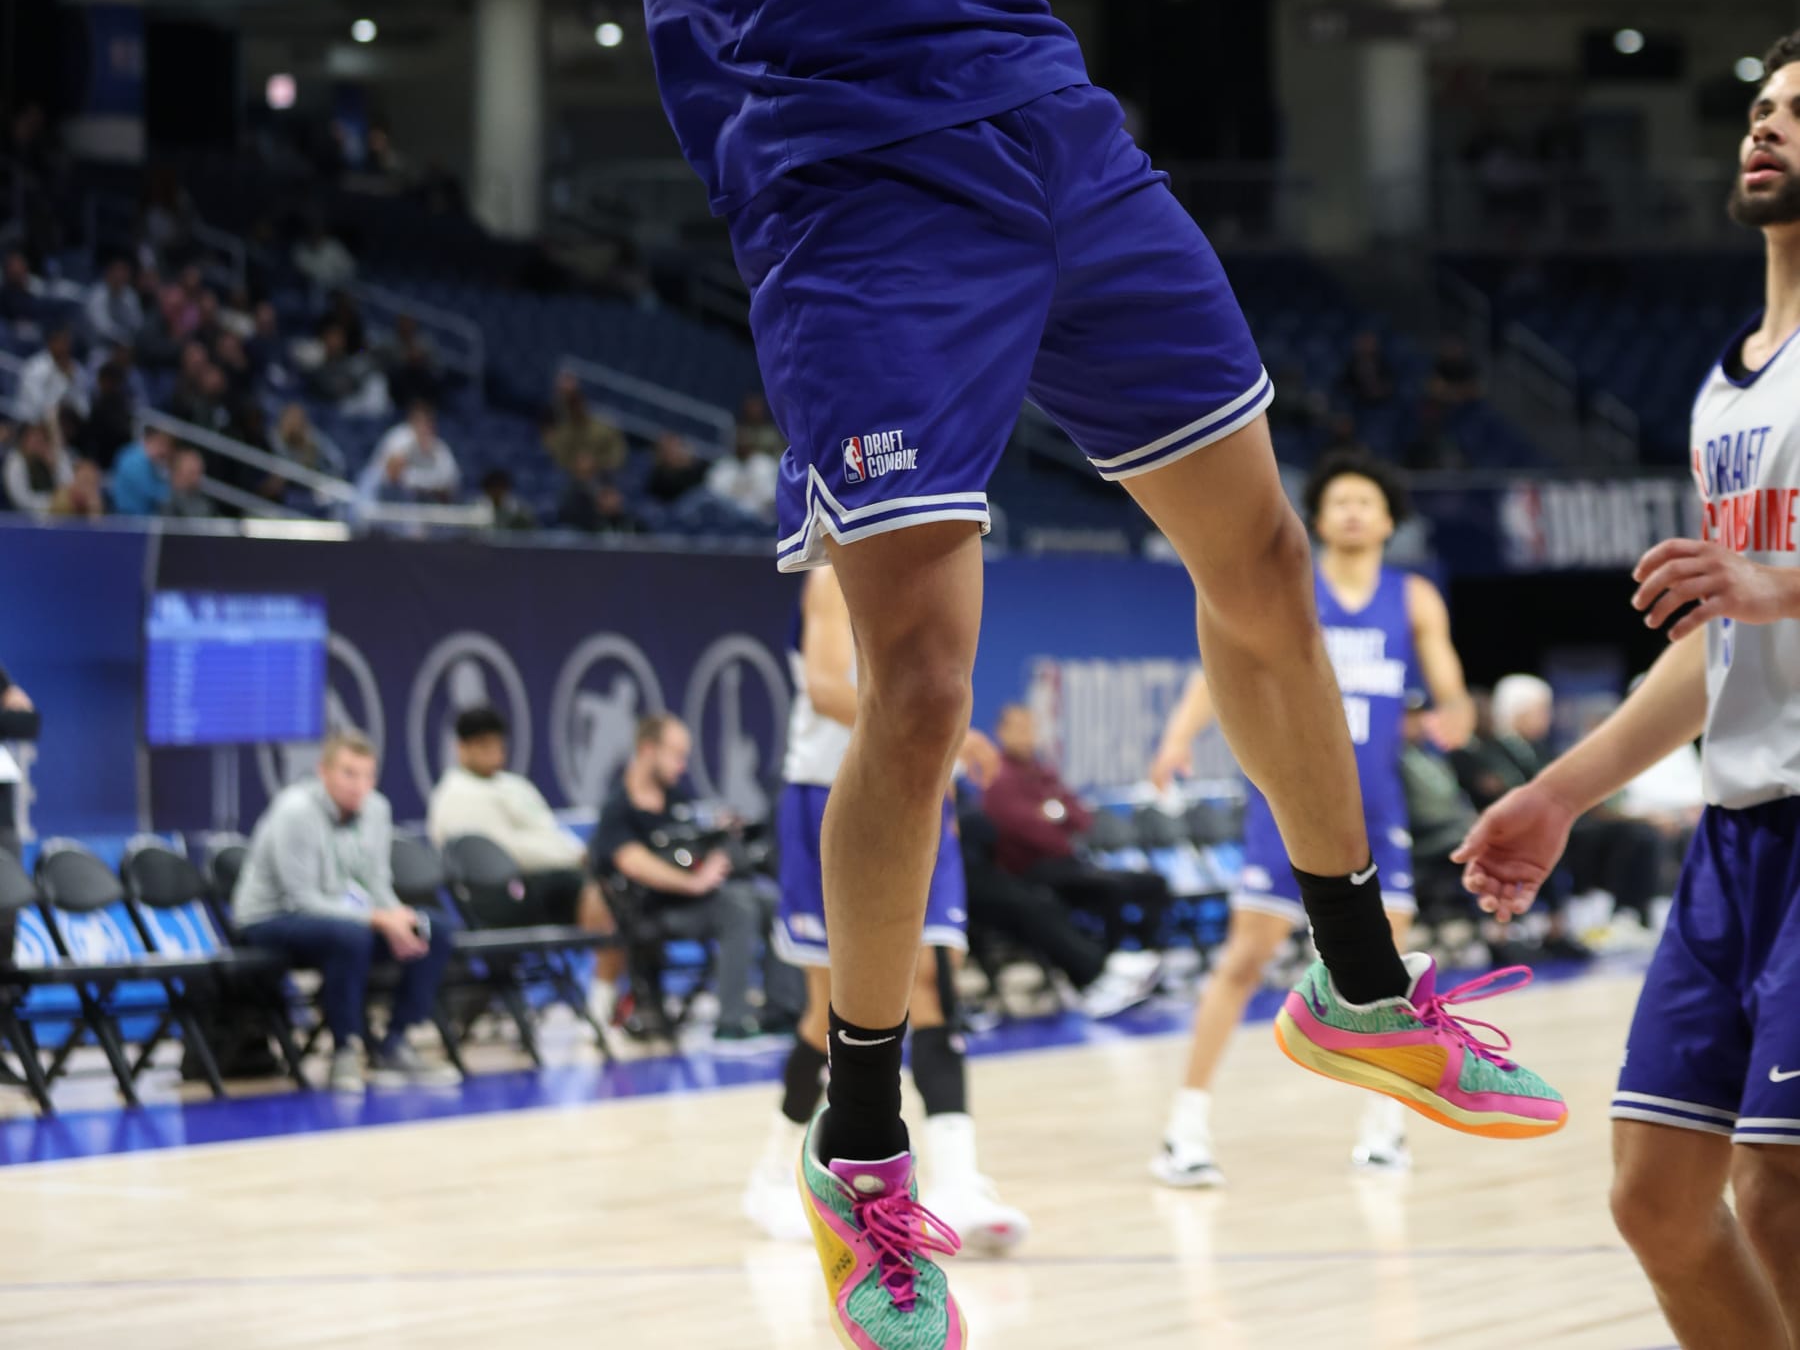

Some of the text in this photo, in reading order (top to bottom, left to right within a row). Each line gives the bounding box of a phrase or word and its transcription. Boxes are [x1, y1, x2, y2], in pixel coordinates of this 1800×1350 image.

[863, 429, 903, 457] DRAFT
[867, 448, 918, 479] COMBINE
[1705, 426, 1772, 496] DRAFT
